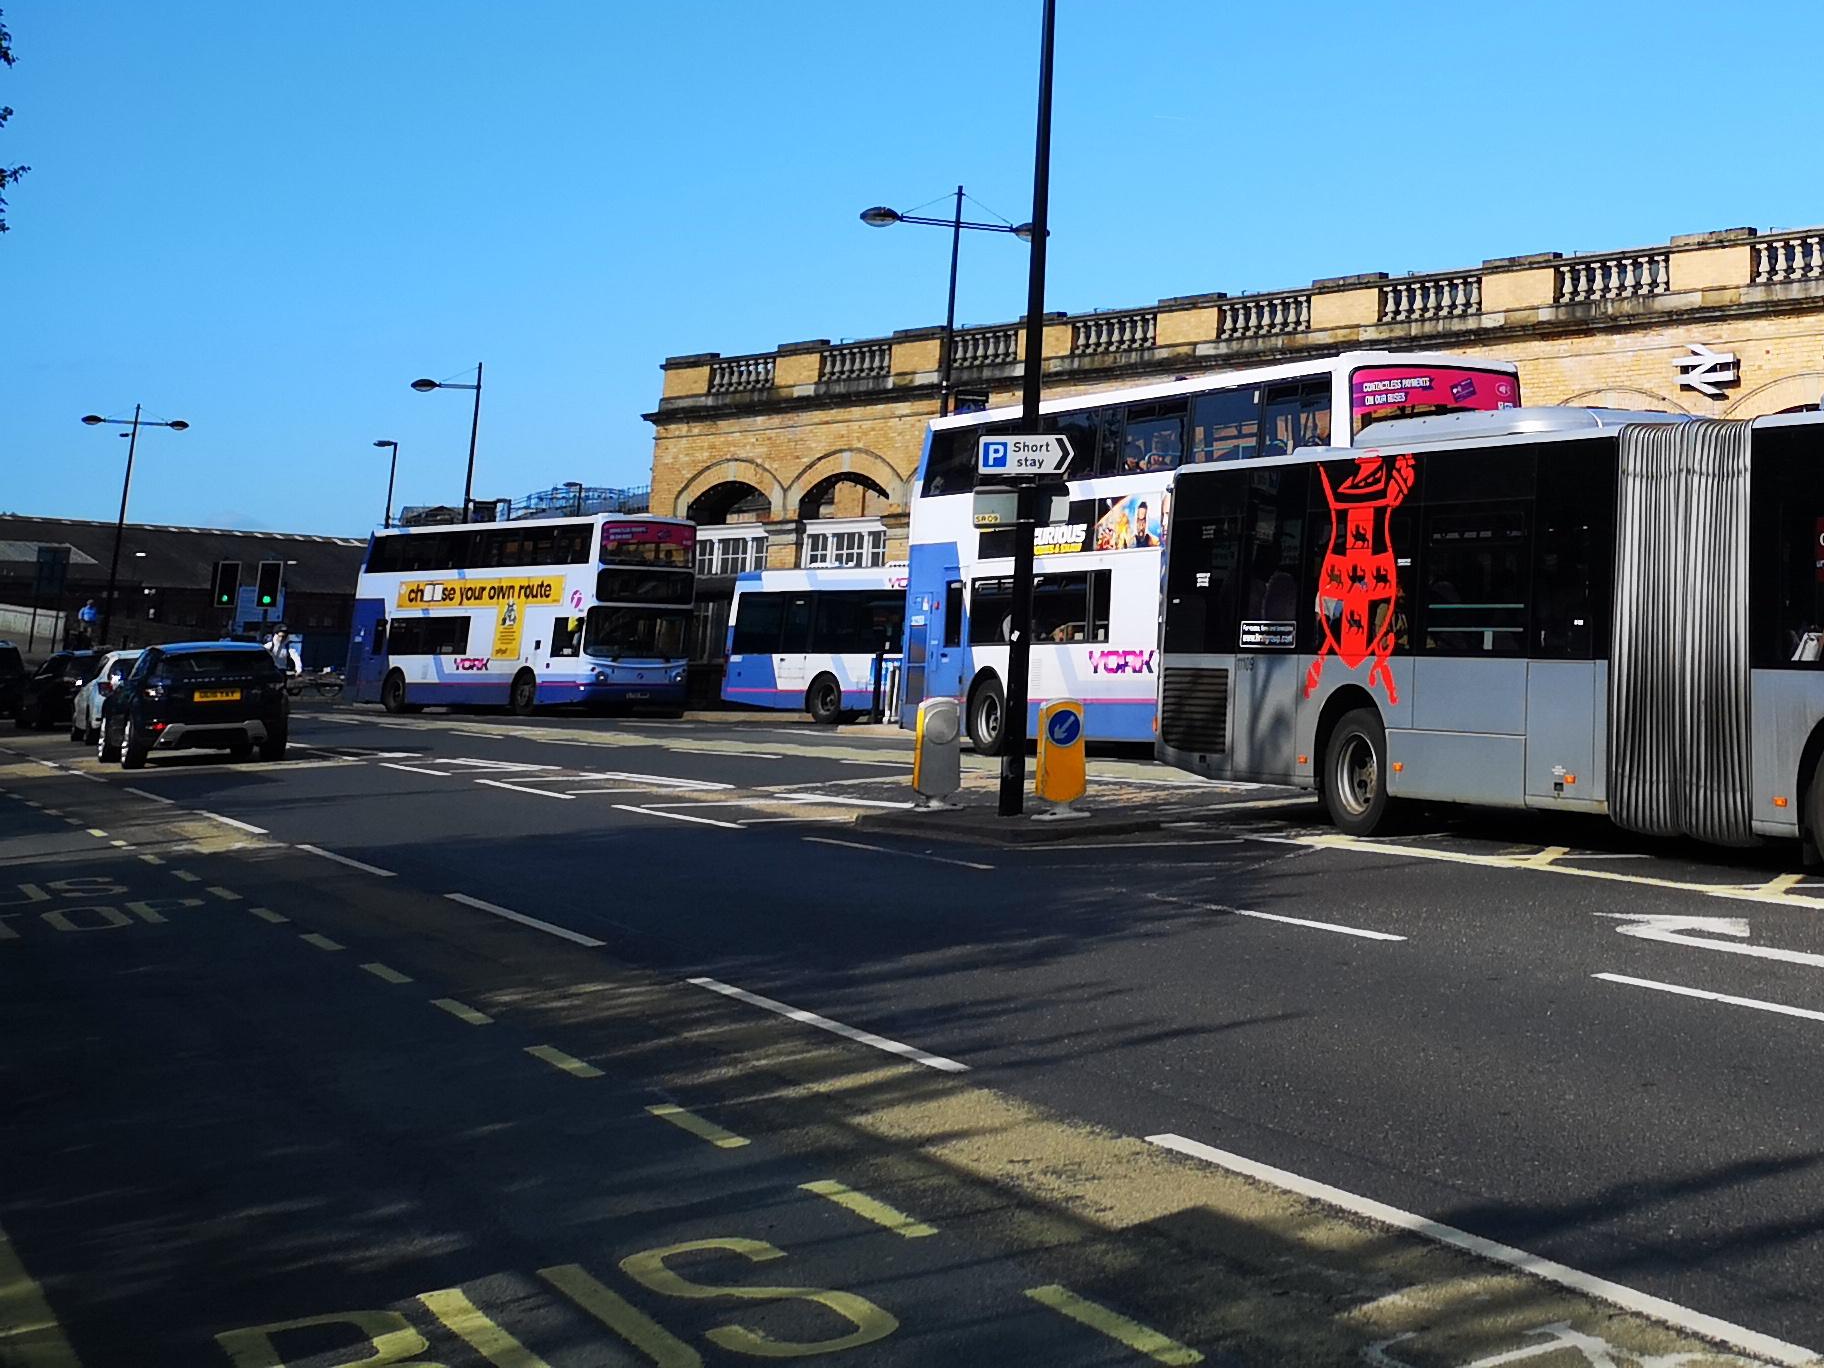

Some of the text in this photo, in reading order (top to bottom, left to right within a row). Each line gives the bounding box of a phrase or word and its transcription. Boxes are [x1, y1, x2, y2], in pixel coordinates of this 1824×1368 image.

[988, 444, 1004, 466] P
[1012, 441, 1050, 453] Short
[1017, 456, 1045, 469] stay
[1034, 524, 1087, 546] URIOUS
[407, 580, 552, 606] chse your own route
[453, 657, 490, 671] YORK
[1088, 650, 1155, 674] YORK
[0, 877, 129, 905] US
[0, 898, 206, 939] TOP
